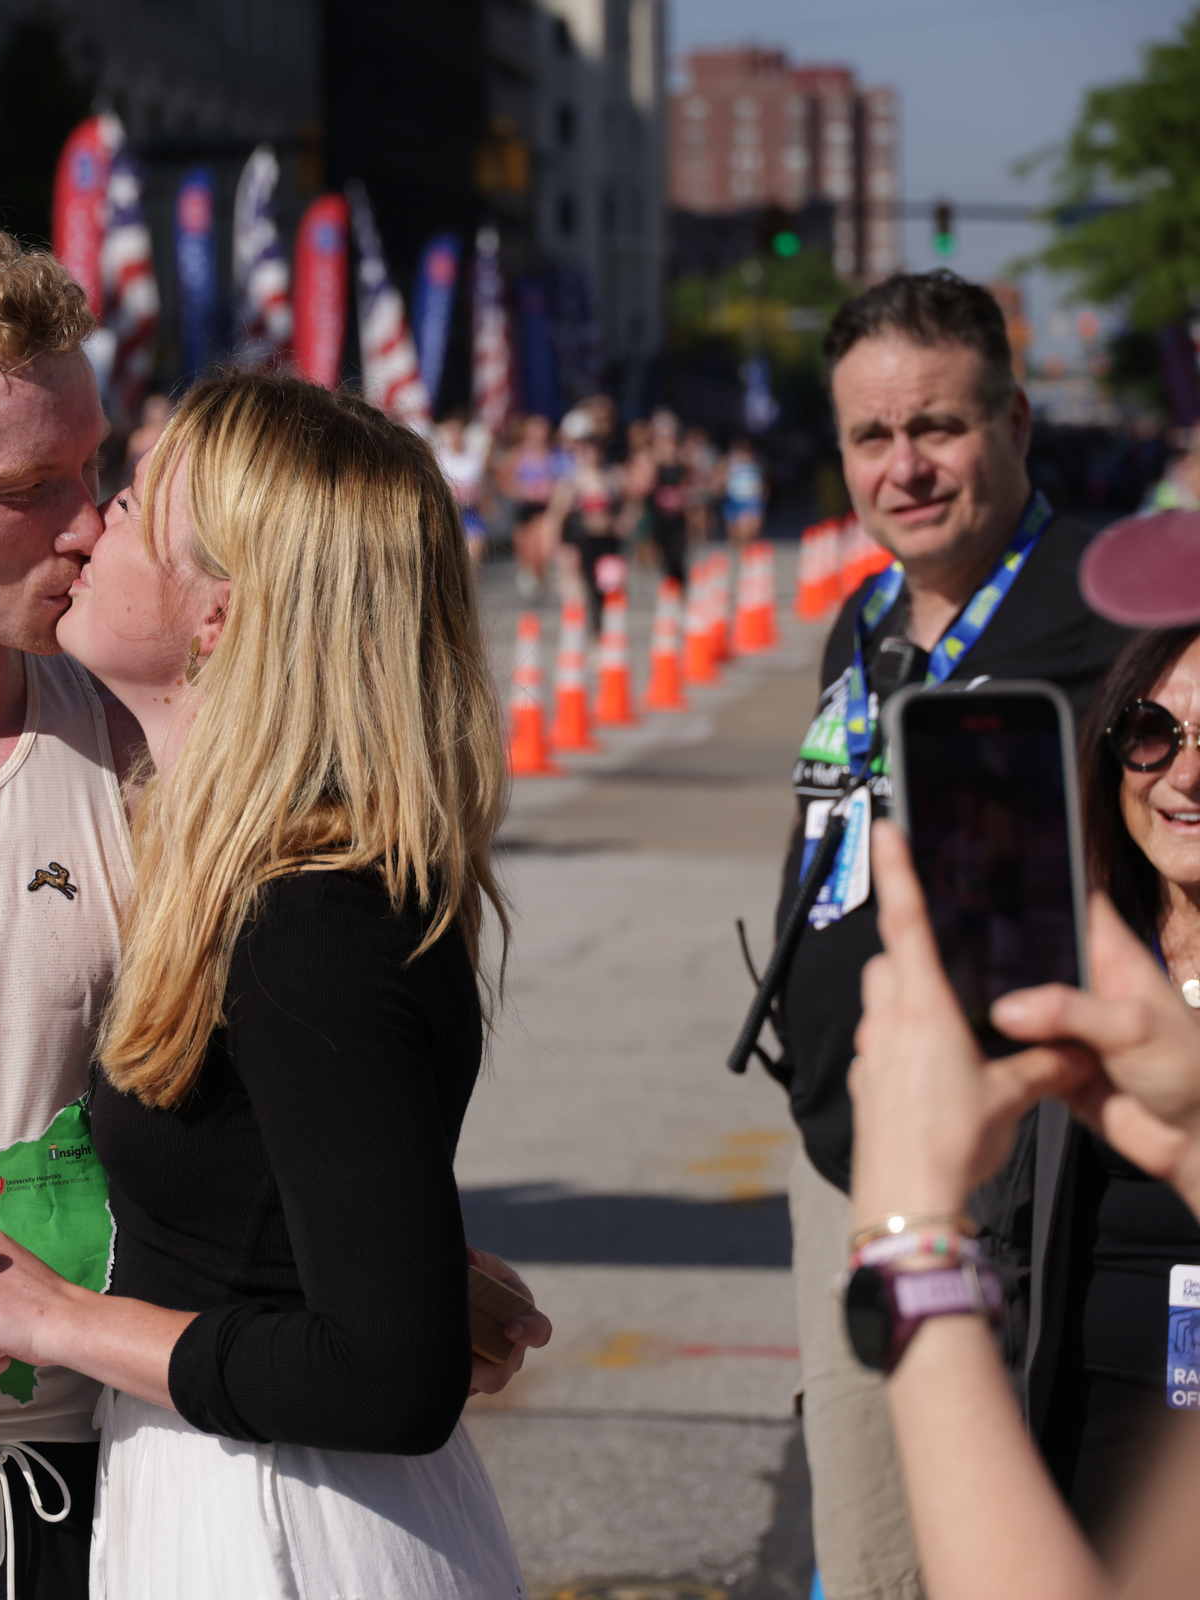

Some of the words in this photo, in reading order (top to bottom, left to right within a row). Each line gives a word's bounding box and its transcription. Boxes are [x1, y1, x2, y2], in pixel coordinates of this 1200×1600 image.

[51, 1144, 92, 1159] Insight
[6, 1177, 35, 1186] University
[36, 1173, 62, 1182] Hospitals
[32, 1180, 47, 1189] Sports
[48, 1178, 70, 1186] Medicine
[70, 1176, 90, 1184] Institute
[1174, 1368, 1200, 1384] RA
[1172, 1390, 1200, 1406] OF
